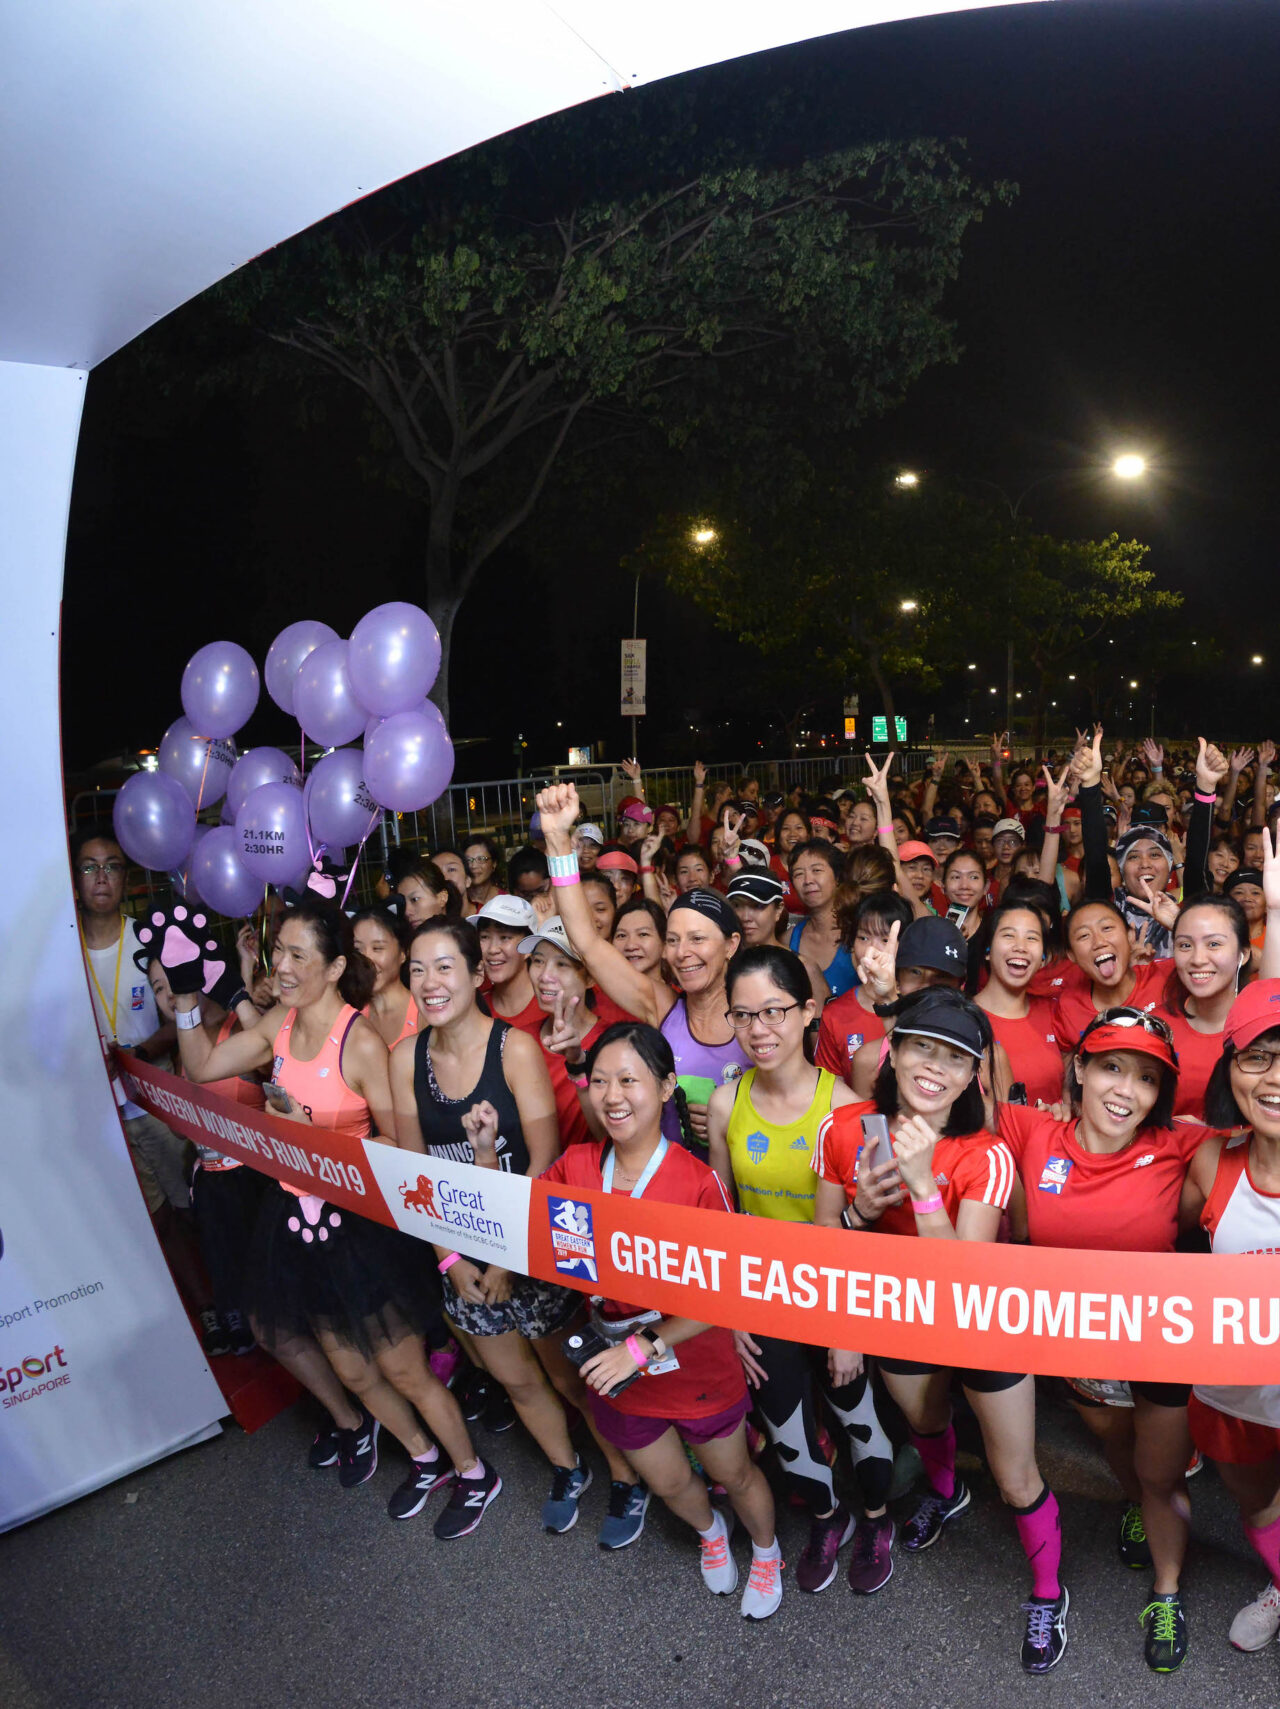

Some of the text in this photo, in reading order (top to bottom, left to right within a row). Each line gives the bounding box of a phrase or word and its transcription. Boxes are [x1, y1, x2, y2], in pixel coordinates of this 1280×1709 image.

[243, 828, 285, 841] 21.1KM
[244, 842, 284, 854] 2:30HR
[143, 1080, 202, 1127] EASTERN
[196, 1105, 273, 1160] WOMEN'S
[269, 1137, 314, 1177] RUN
[312, 1153, 366, 1196] 2019
[438, 1180, 485, 1211] Great
[441, 1202, 504, 1239] Eastern
[555, 1233, 591, 1247] GREAT EASTERN
[34, 1280, 104, 1313] Promotion
[610, 1231, 726, 1292] GREAT
[740, 1254, 935, 1326] EASTERN
[952, 1282, 1194, 1344] WOMEN'S
[2, 1373, 72, 1409] SINGAPORE
